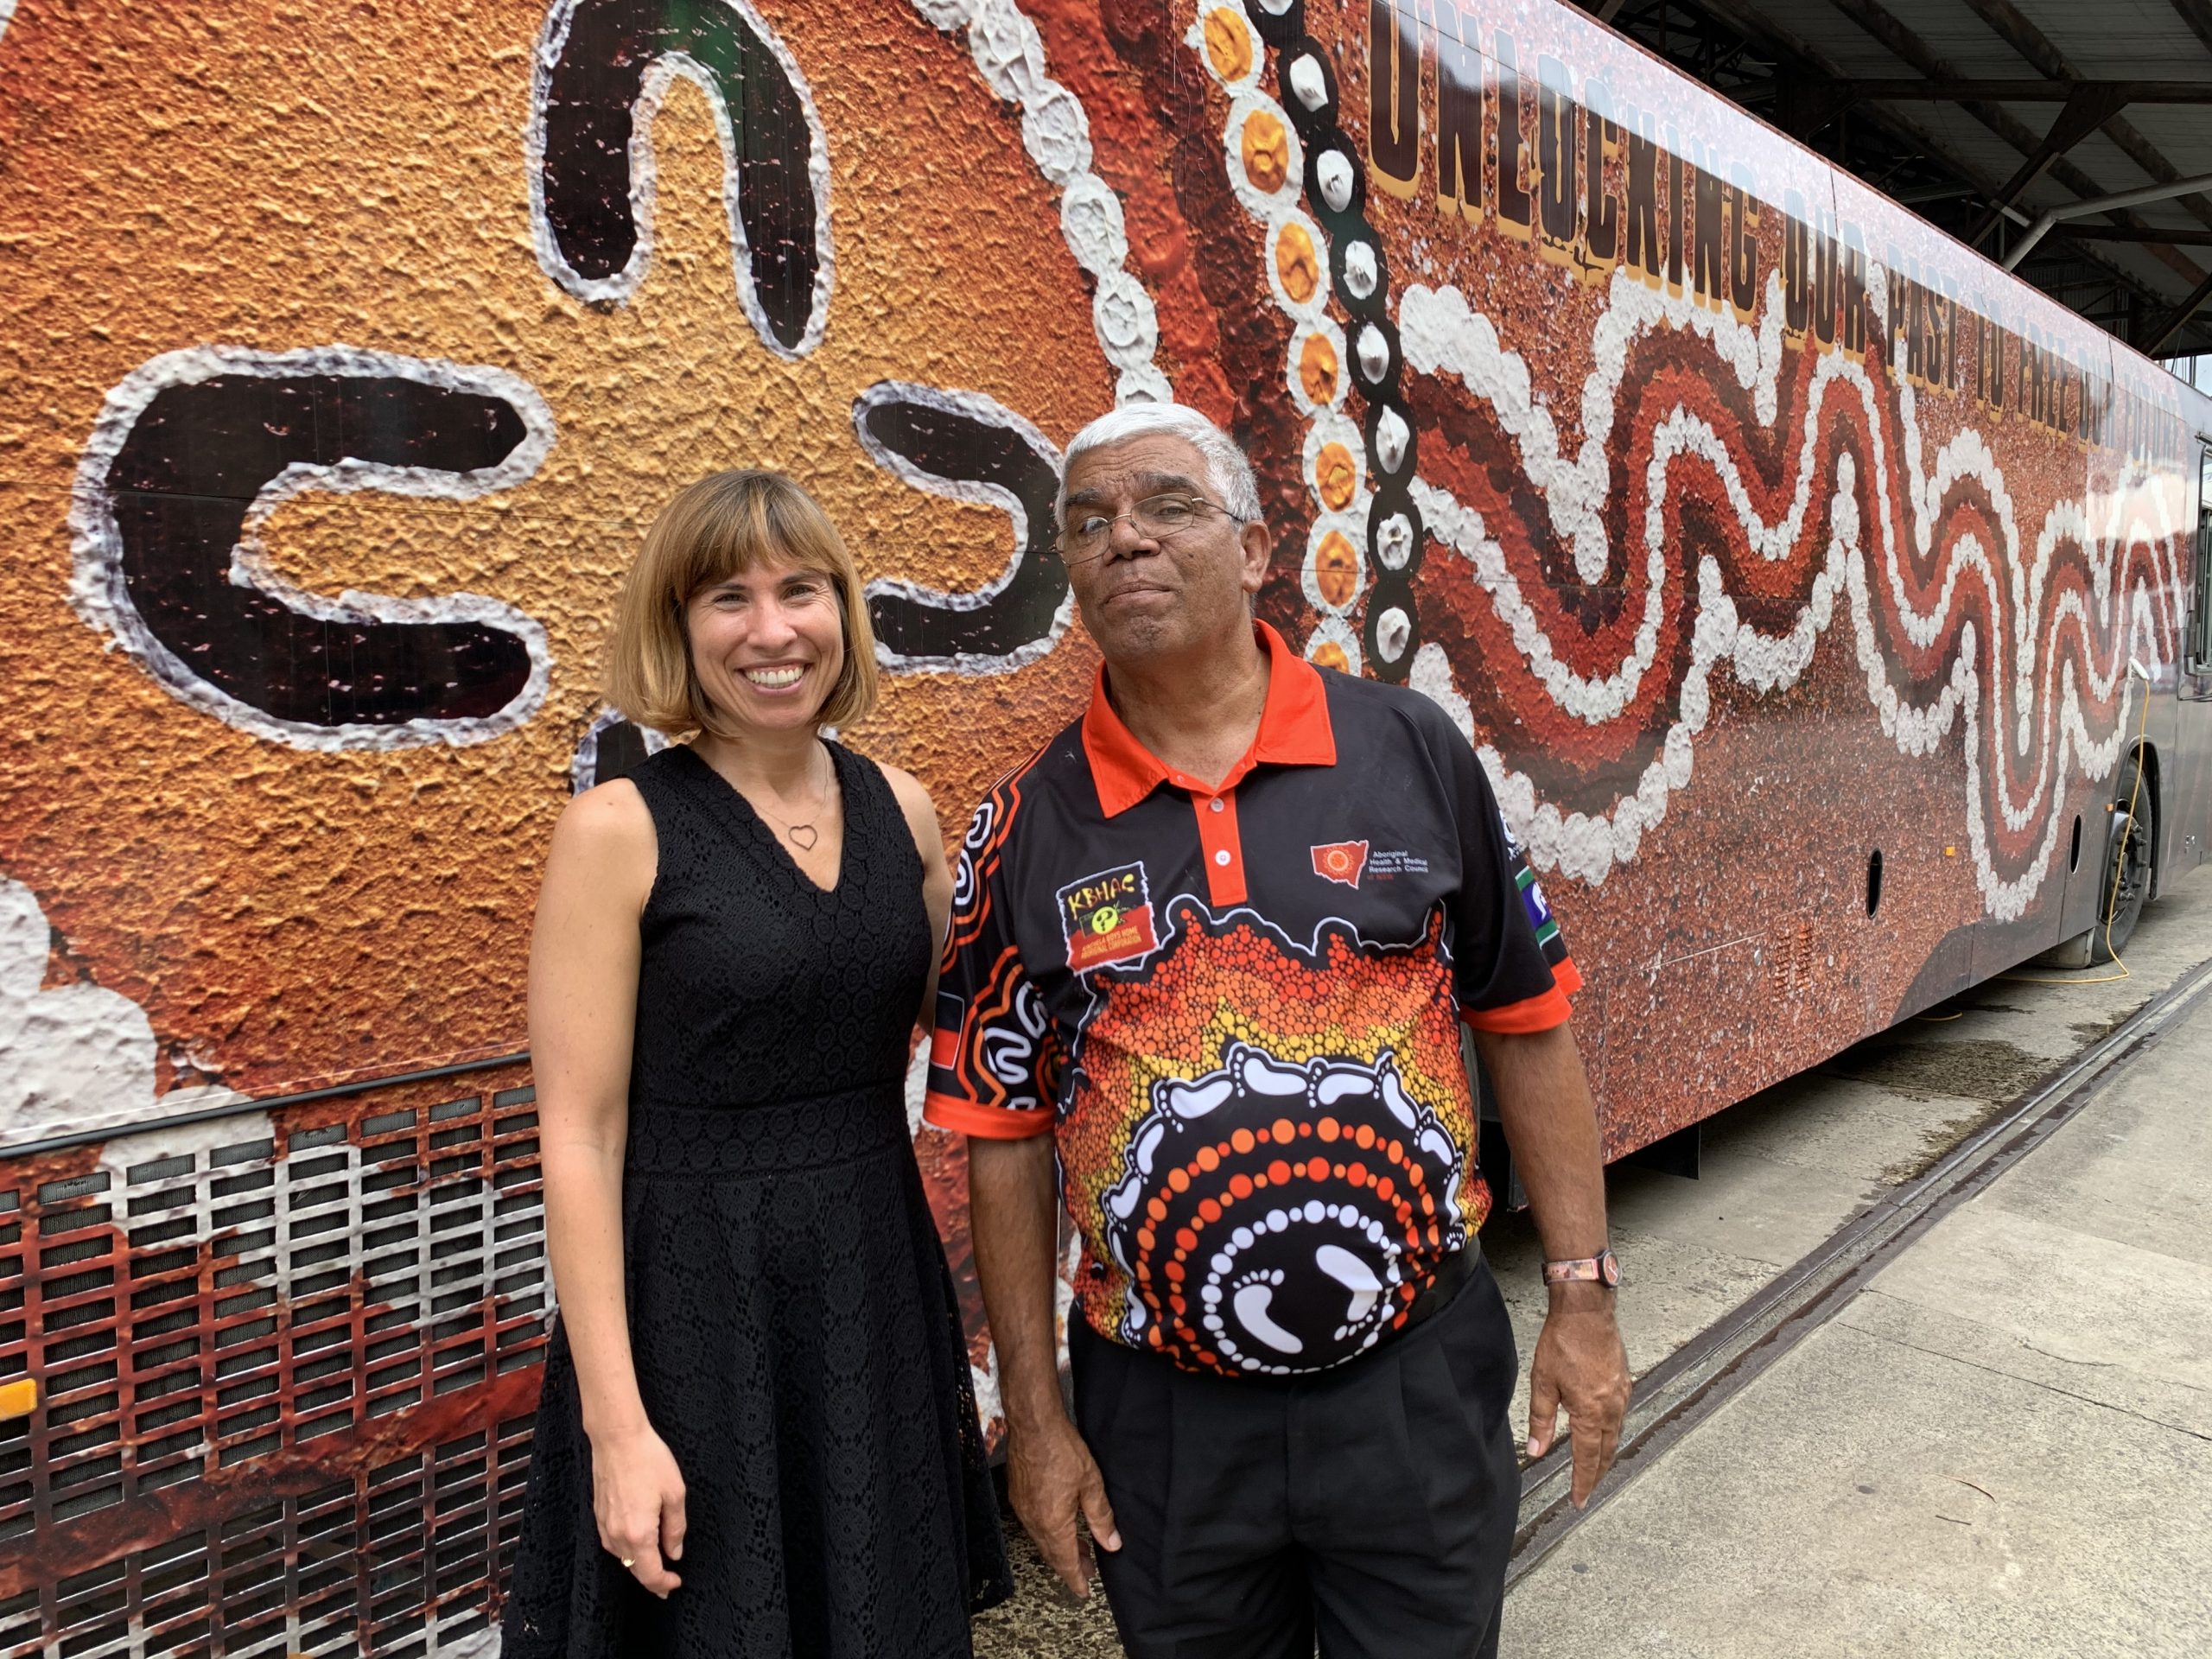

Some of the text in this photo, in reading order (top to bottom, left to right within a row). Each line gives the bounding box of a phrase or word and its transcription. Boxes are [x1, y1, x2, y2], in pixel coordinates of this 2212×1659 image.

[1368, 0, 1758, 322] UNLOCKING
[1783, 188, 1868, 364] OUR
[1886, 242, 1958, 398] PAST
[1973, 289, 2005, 421] TO
[2018, 315, 2069, 444] FREE
[2077, 346, 2115, 454] OUR
[1067, 874, 1135, 921] KBHAC
